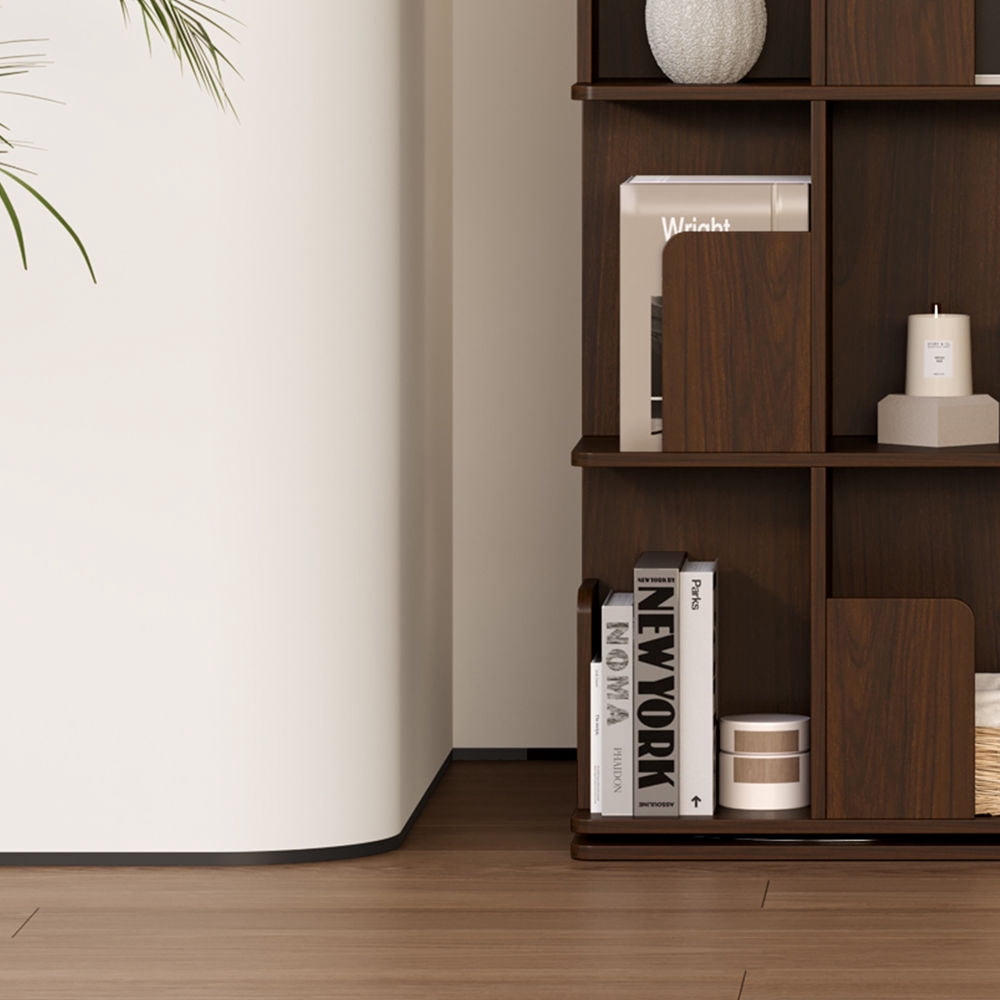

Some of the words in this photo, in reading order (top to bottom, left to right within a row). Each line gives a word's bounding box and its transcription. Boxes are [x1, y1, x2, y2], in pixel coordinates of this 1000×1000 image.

[690, 579, 702, 611] Parks
[605, 622, 630, 727] NOMA
[613, 747, 622, 794] PHAIDON
